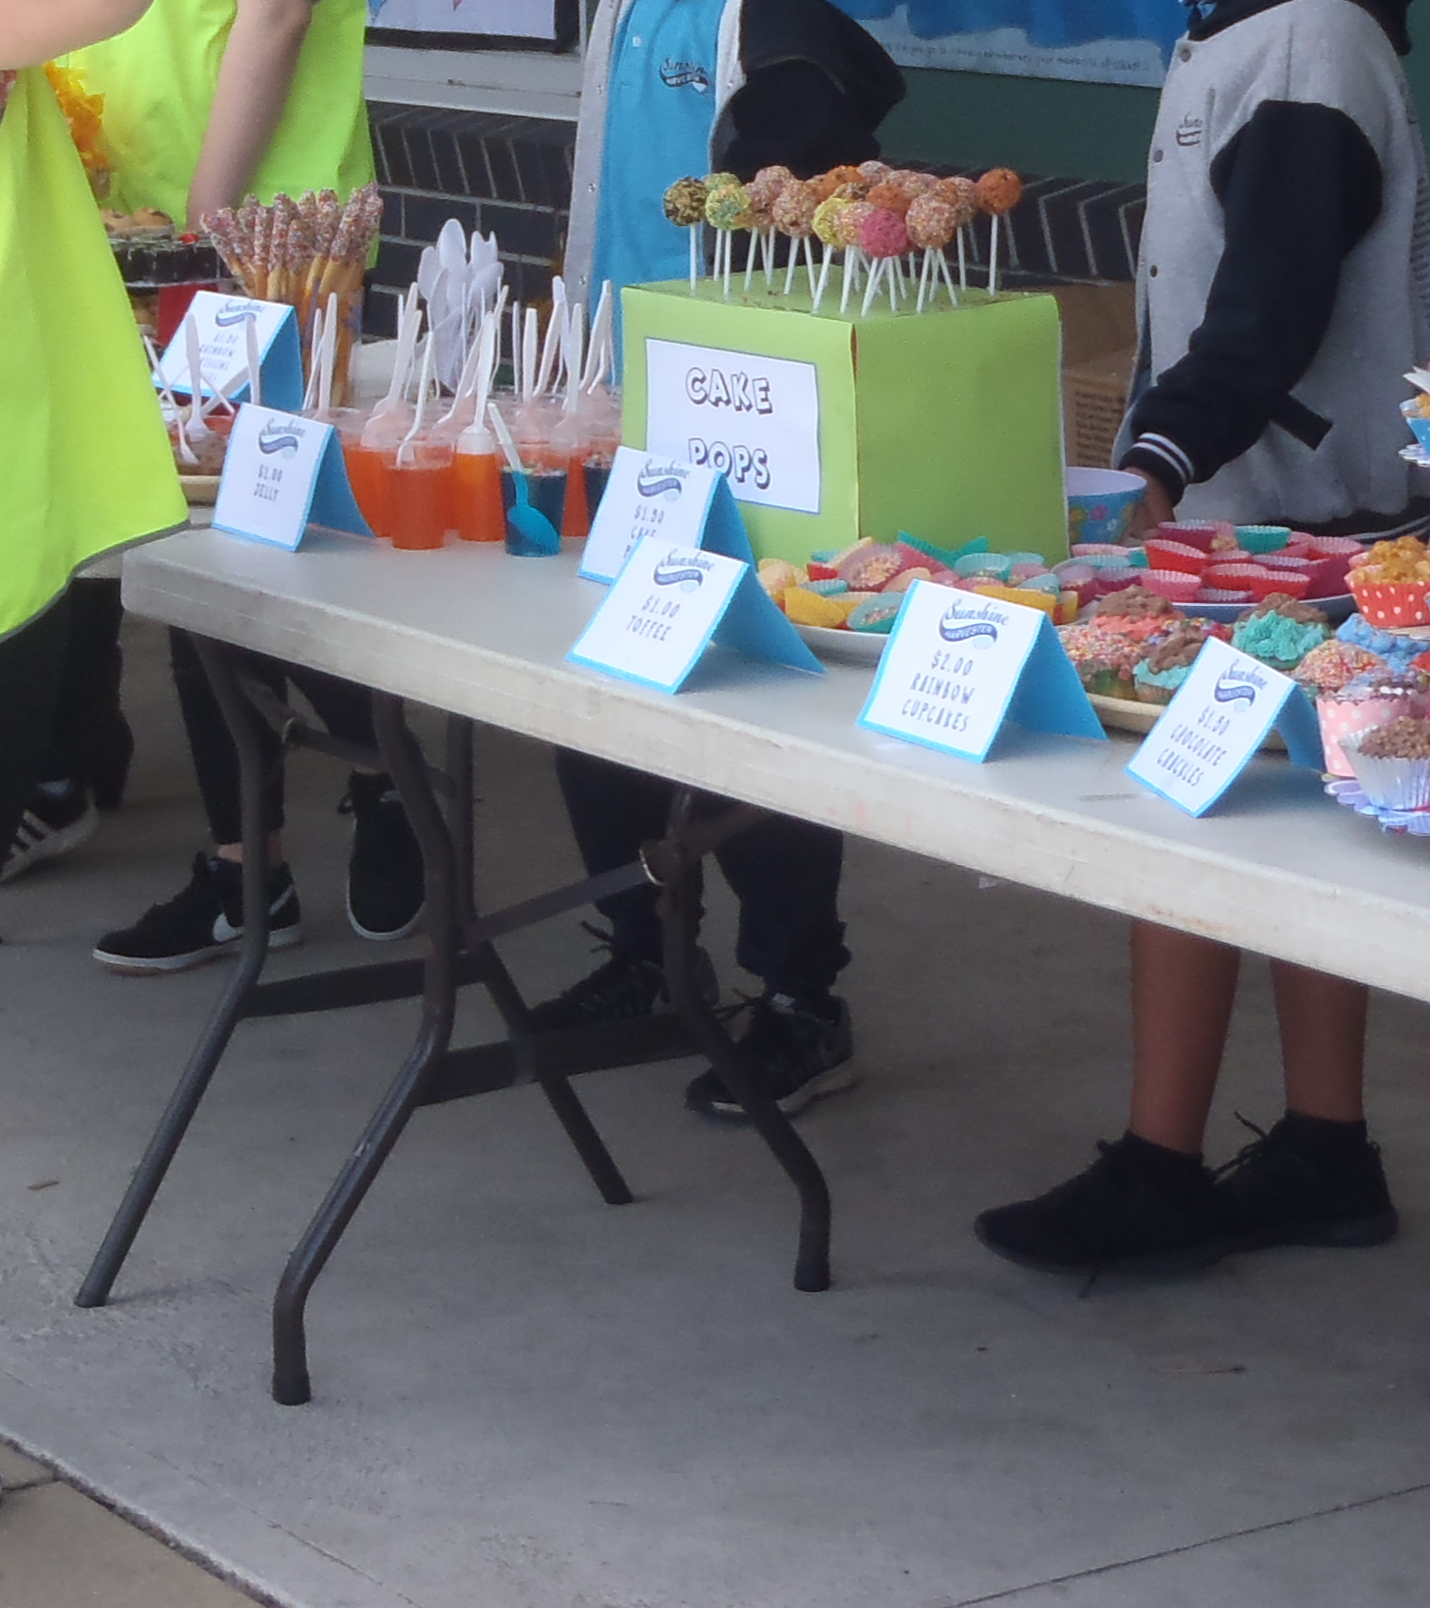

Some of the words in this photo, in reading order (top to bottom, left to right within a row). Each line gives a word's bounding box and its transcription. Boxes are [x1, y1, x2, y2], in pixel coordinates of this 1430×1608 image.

[685, 366, 774, 416] CAKE
[687, 437, 771, 490] POPS
[252, 482, 280, 503] JELLY
[633, 504, 666, 525] $1.50
[660, 548, 716, 572] Sunshine
[640, 594, 682, 619] $1.00
[944, 598, 1011, 627] Sunshine
[625, 614, 673, 643] TOFFEE
[930, 648, 974, 677] $2.00
[1221, 657, 1269, 692] Sunshine
[909, 671, 976, 706] RAINBOW
[900, 697, 970, 734] CUPCAKES
[1196, 704, 1231, 738] $1.50
[1169, 722, 1229, 768] CHOCOLATE
[1156, 747, 1206, 788] CRACKLES
